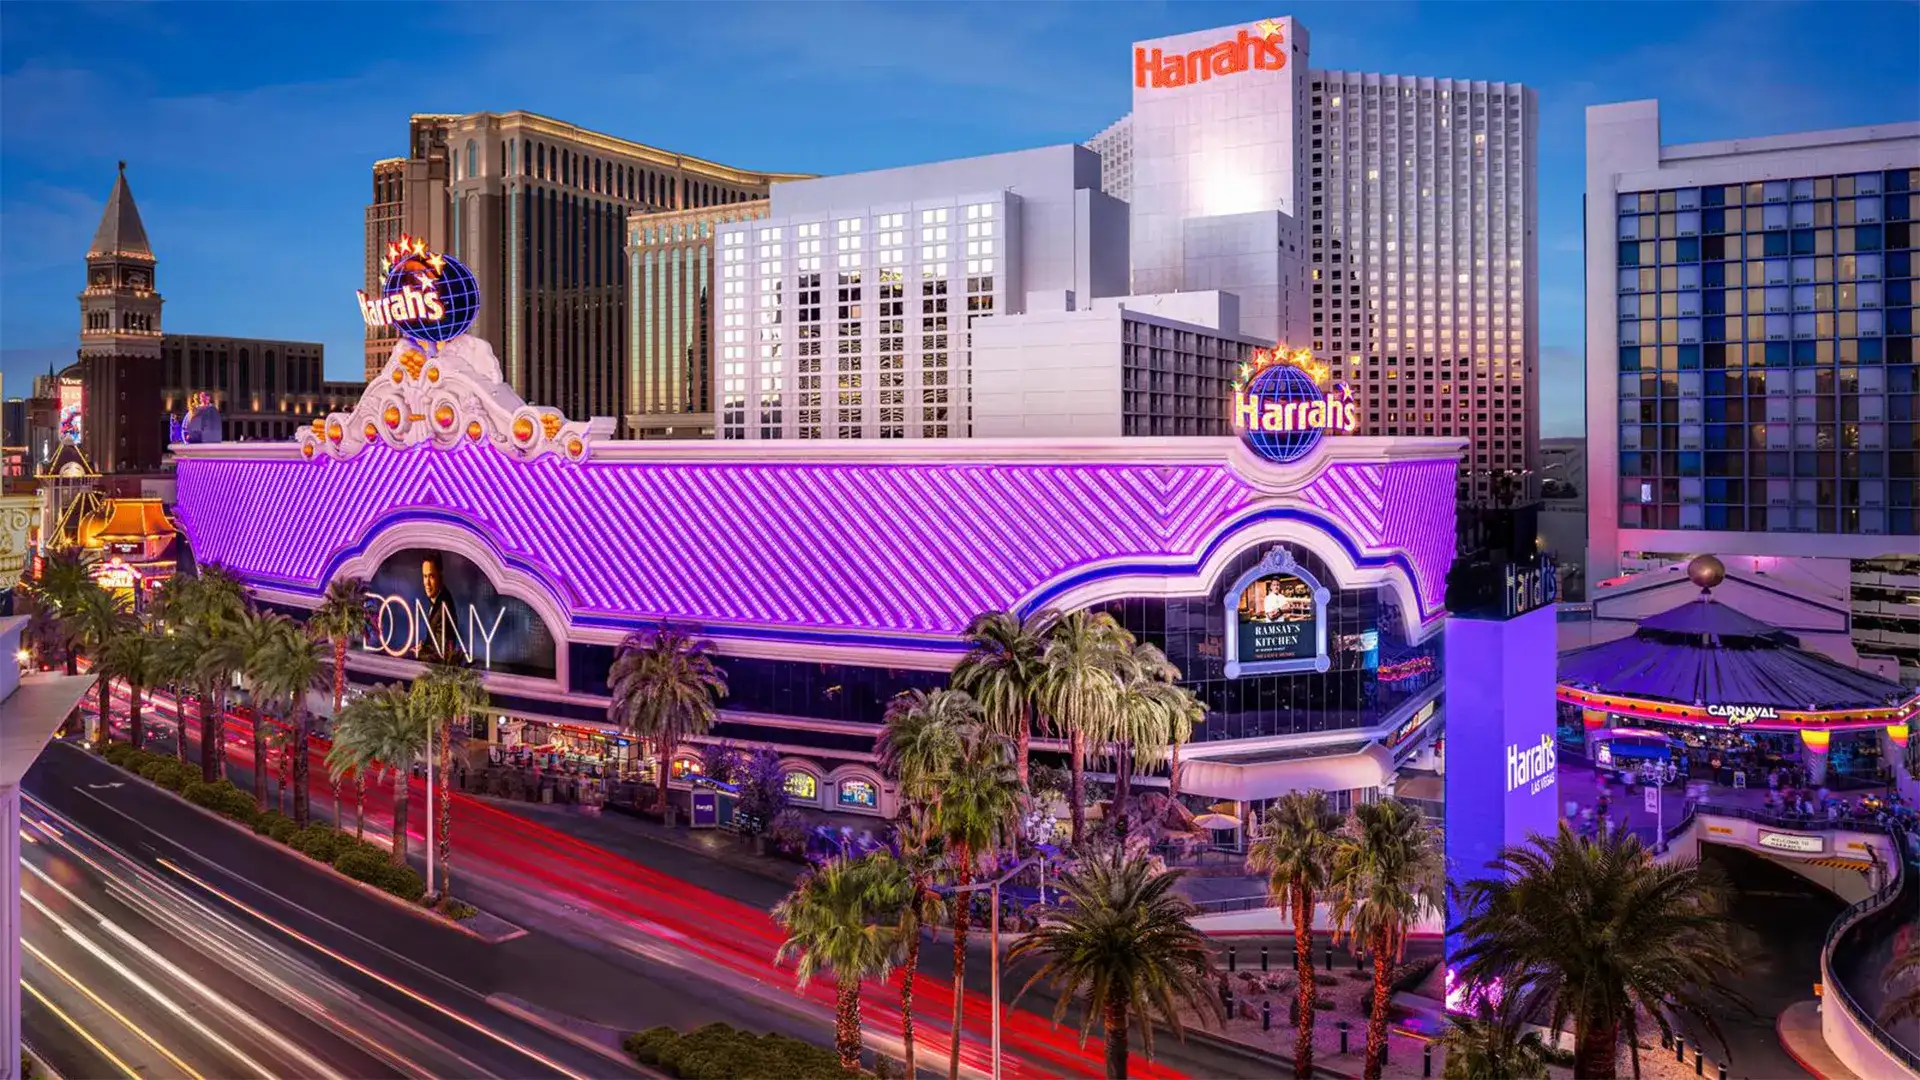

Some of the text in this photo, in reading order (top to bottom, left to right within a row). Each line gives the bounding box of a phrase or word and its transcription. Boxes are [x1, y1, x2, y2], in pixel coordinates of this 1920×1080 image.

[363, 592, 506, 669] DONNY
[1255, 624, 1301, 635] RAMSAY'S
[1255, 635, 1298, 647] KITCHEN
[1708, 705, 1778, 718] CARNAVAL
[1531, 772, 1555, 795] LAS VEGAS
